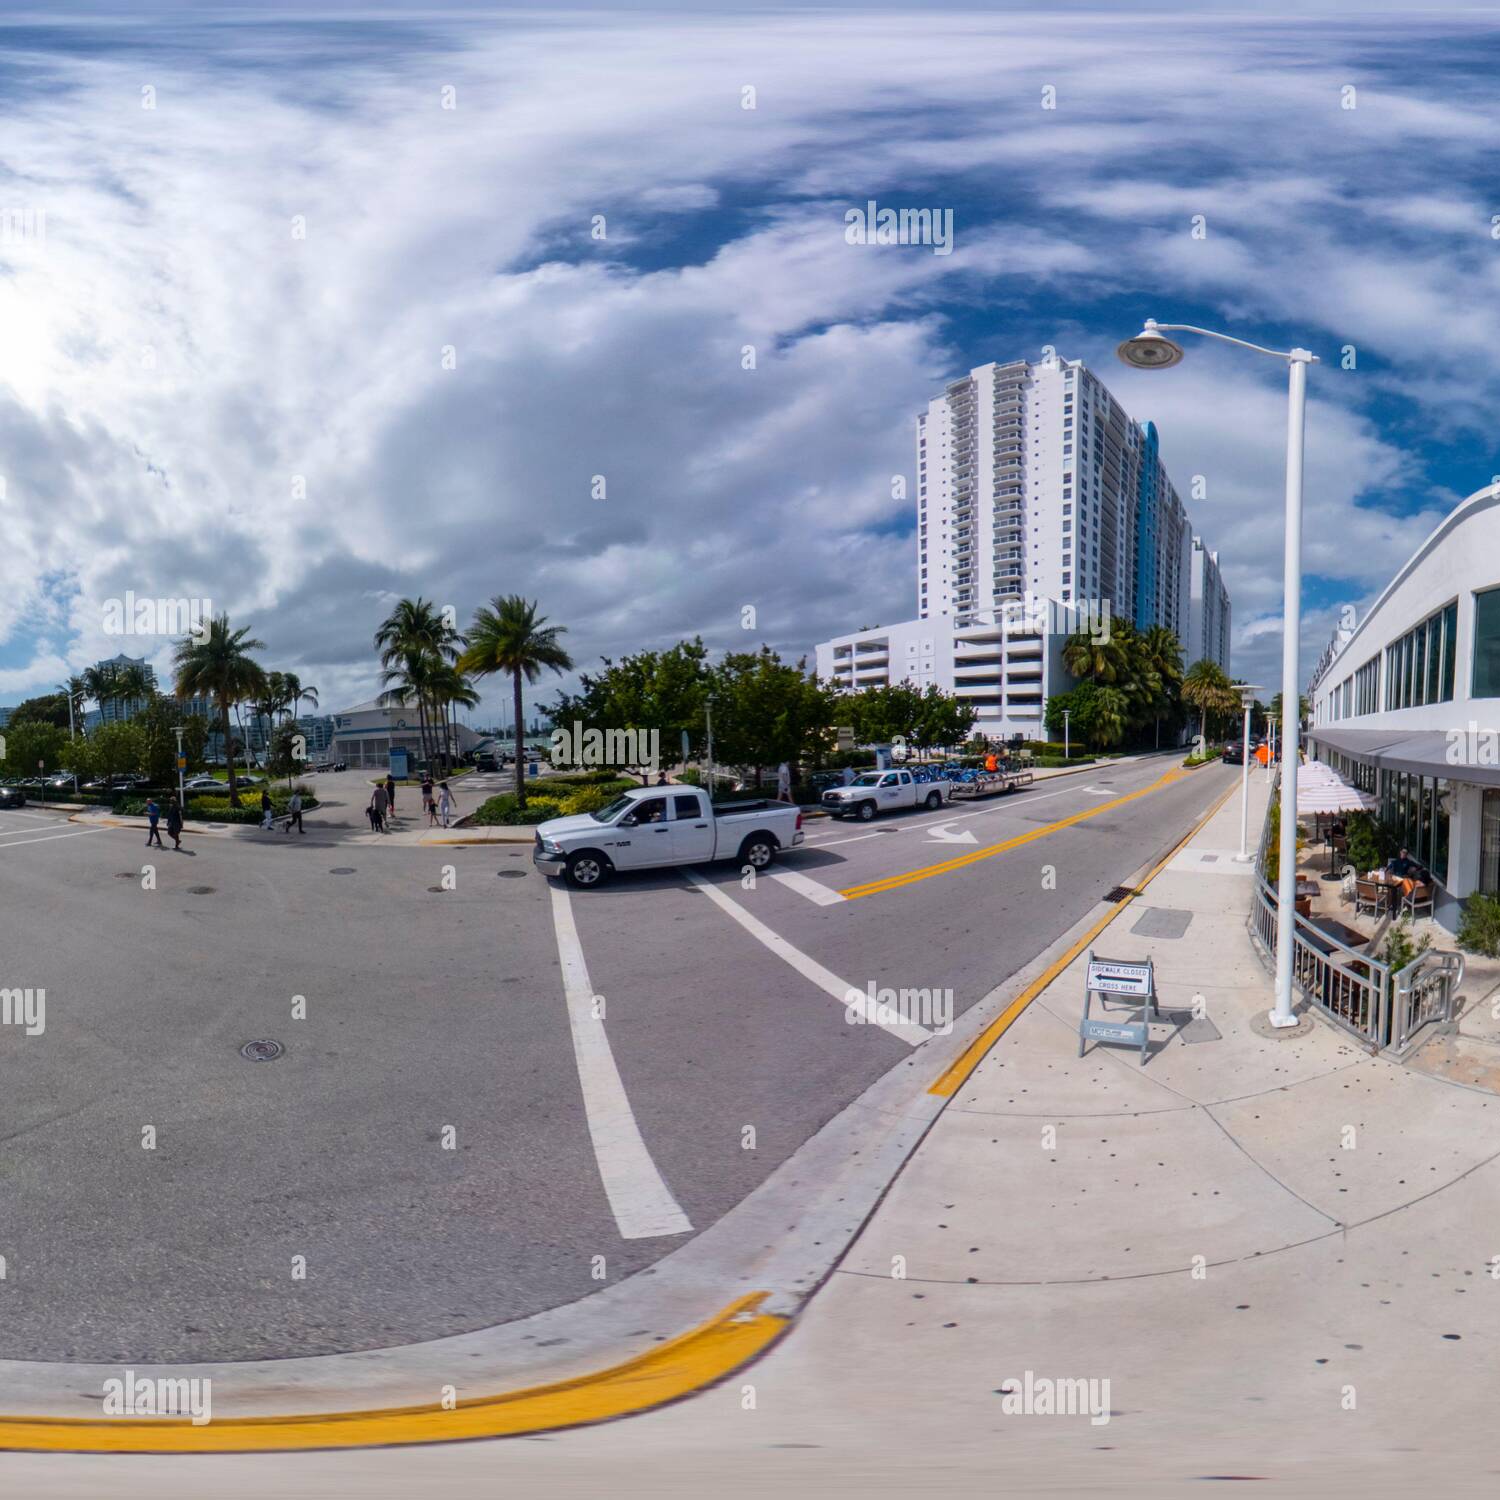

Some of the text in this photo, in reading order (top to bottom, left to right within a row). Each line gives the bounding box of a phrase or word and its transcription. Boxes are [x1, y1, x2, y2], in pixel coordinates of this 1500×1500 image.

[1091, 965, 1147, 976] SIDEWALK CLOSED
[1098, 982, 1137, 991] CROSS HERE
